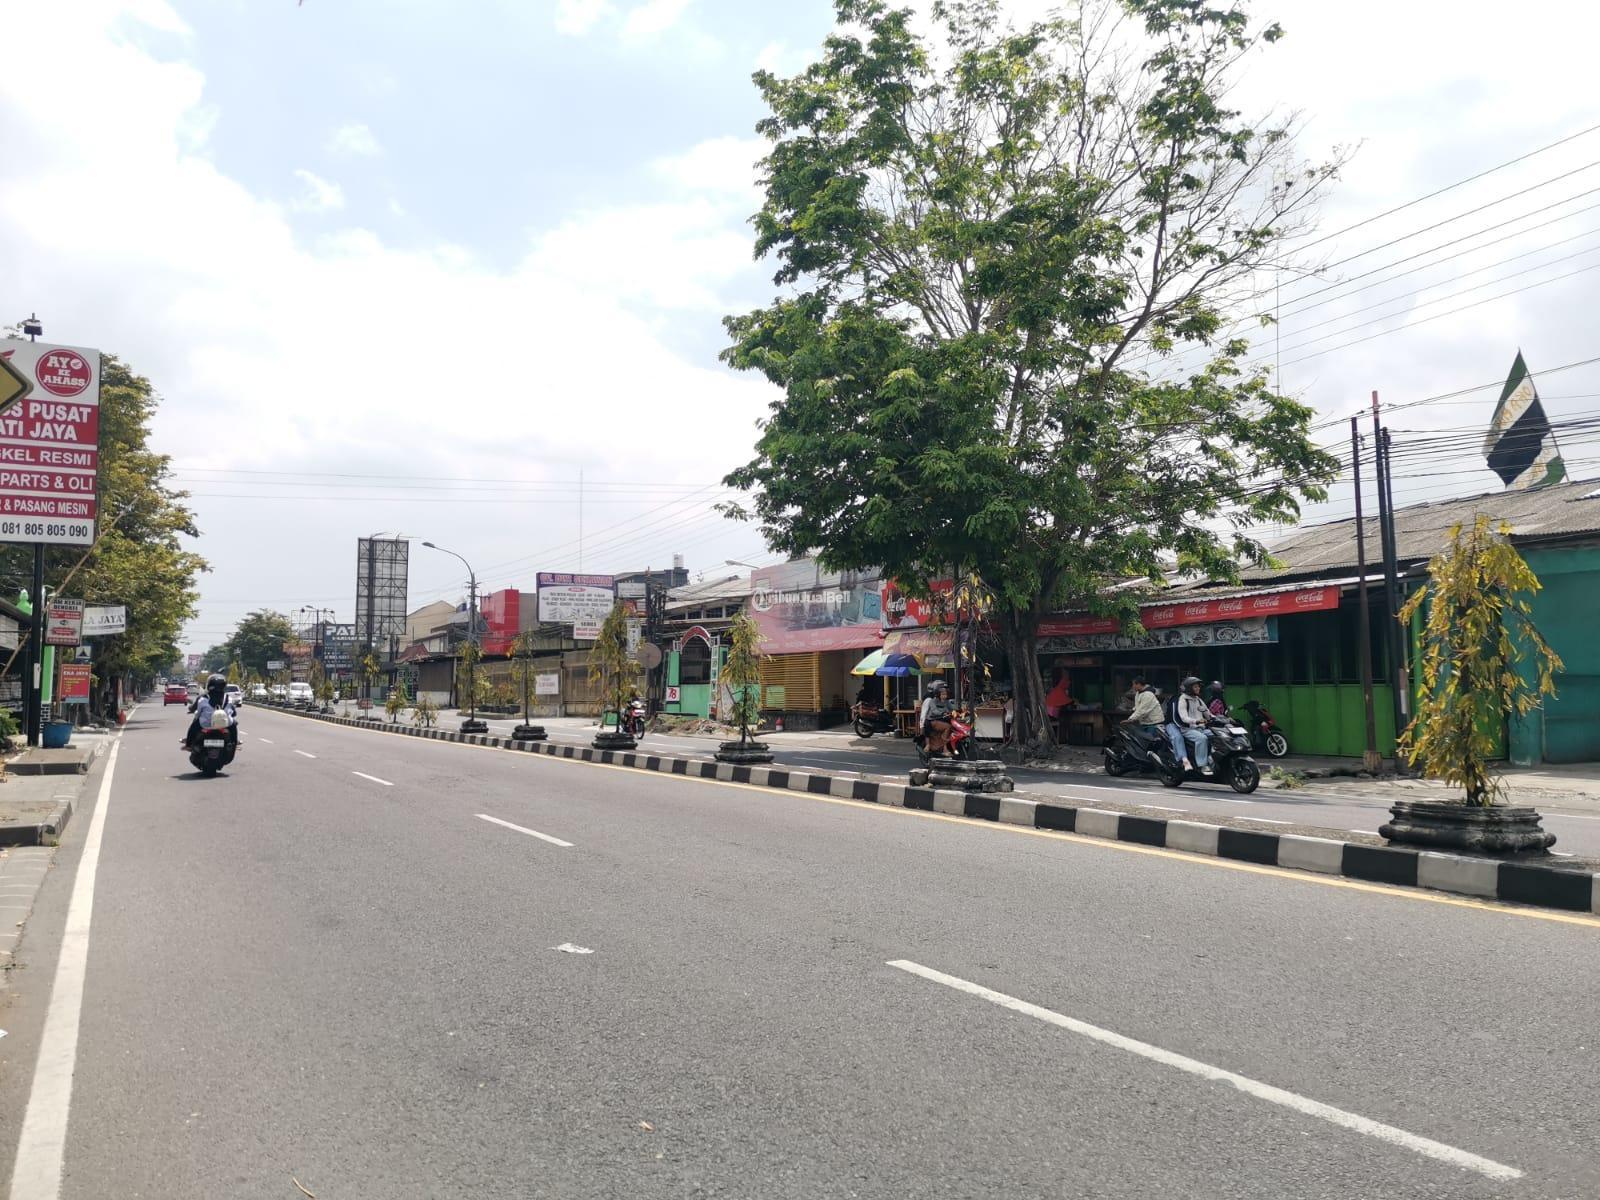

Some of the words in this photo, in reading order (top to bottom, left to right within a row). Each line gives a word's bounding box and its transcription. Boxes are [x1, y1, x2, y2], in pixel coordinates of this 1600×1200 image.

[43, 375, 86, 387] AHASS
[58, 369, 71, 377] KE
[29, 402, 92, 423] PUSAT
[29, 422, 78, 441] JAYA
[40, 450, 91, 466] RESMI
[0, 472, 50, 489] PARTS
[54, 475, 64, 489] &
[68, 476, 93, 490] OLI
[4, 498, 11, 512] &
[14, 499, 55, 514] PASANG
[57, 501, 88, 515] MESIN
[2, 521, 21, 535] 081
[25, 522, 44, 536] 805
[47, 524, 66, 537] 805
[69, 525, 88, 537] 090
